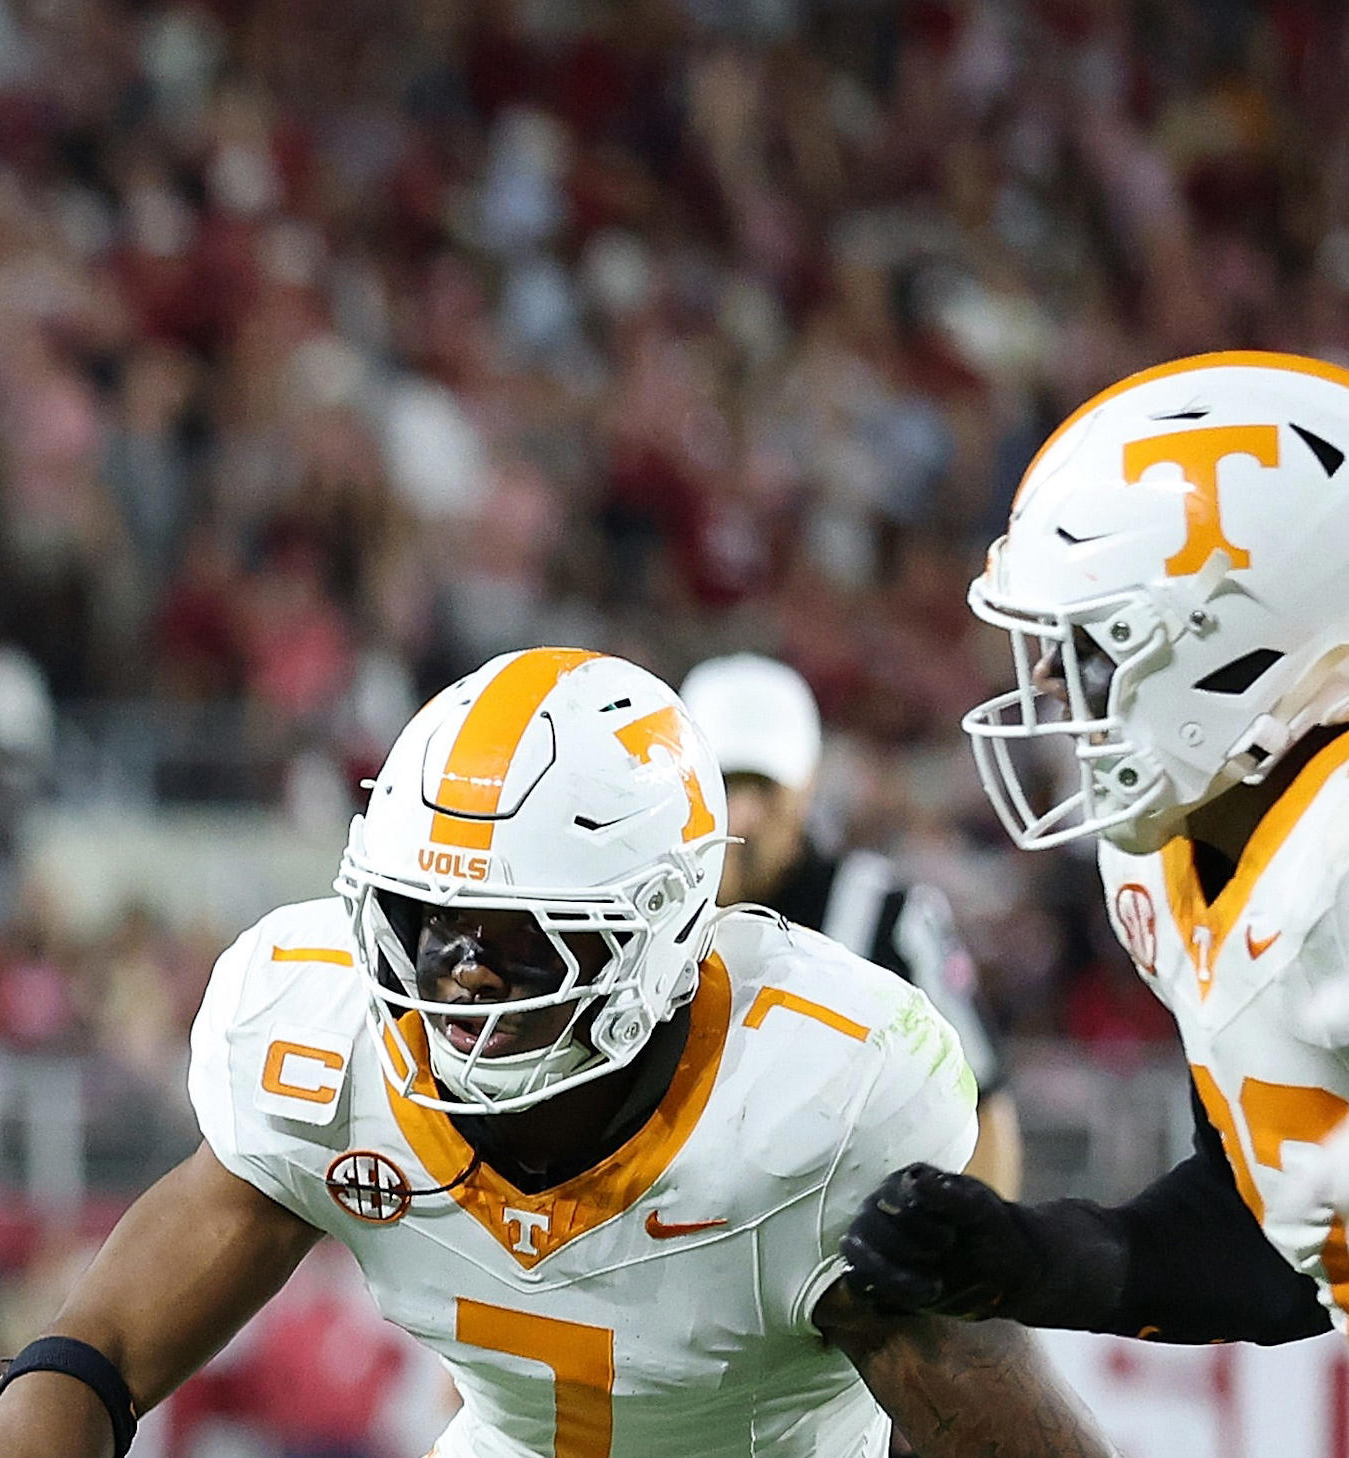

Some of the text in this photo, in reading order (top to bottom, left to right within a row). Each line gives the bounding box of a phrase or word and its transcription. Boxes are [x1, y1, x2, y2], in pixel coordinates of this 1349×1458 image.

[1122, 423, 1280, 578] T
[613, 704, 717, 844] T
[417, 847, 489, 882] VOLS
[742, 985, 872, 1043] 7
[261, 1039, 345, 1105] C
[502, 1206, 551, 1257] T
